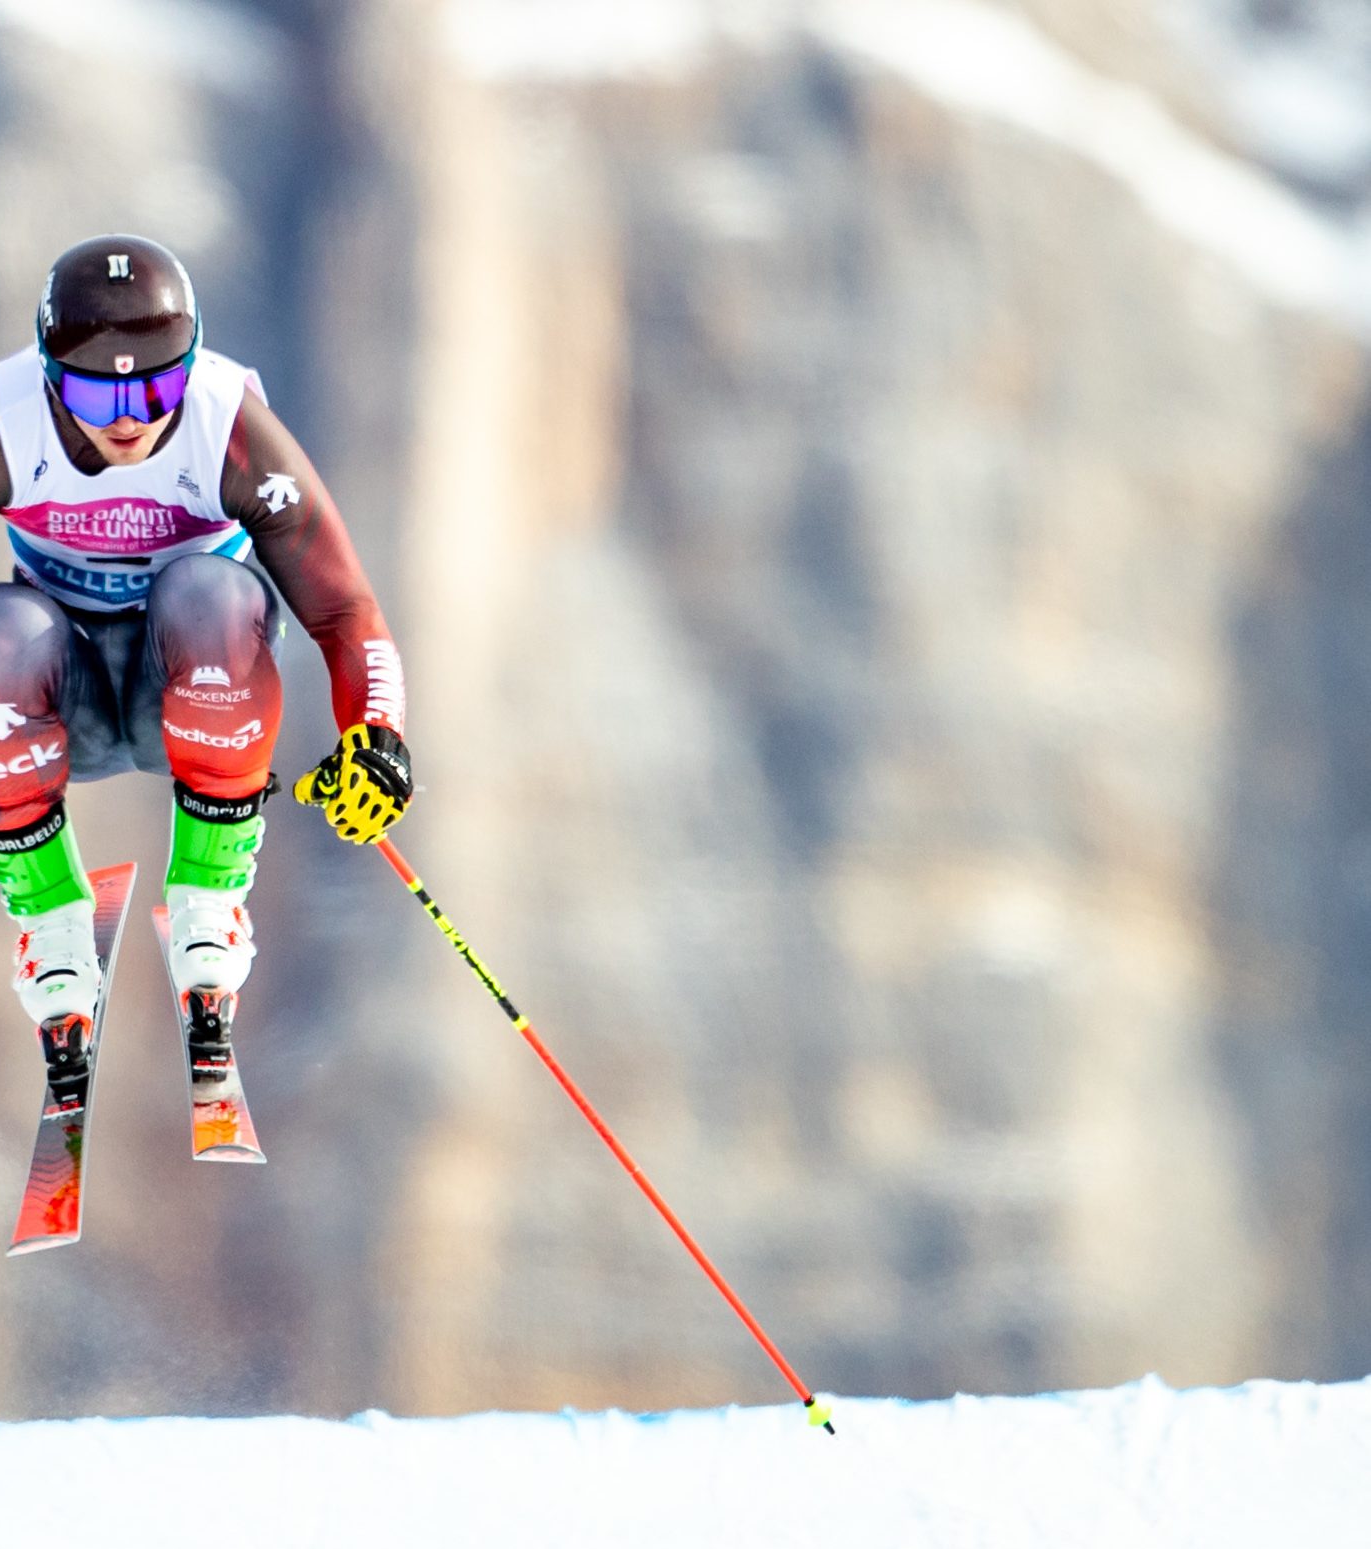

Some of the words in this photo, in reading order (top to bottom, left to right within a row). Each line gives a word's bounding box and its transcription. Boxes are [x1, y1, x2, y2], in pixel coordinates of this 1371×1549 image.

[48, 519, 176, 540] BELLUNESI
[174, 686, 252, 703] MACKENZIE
[362, 640, 405, 734] CANADA
